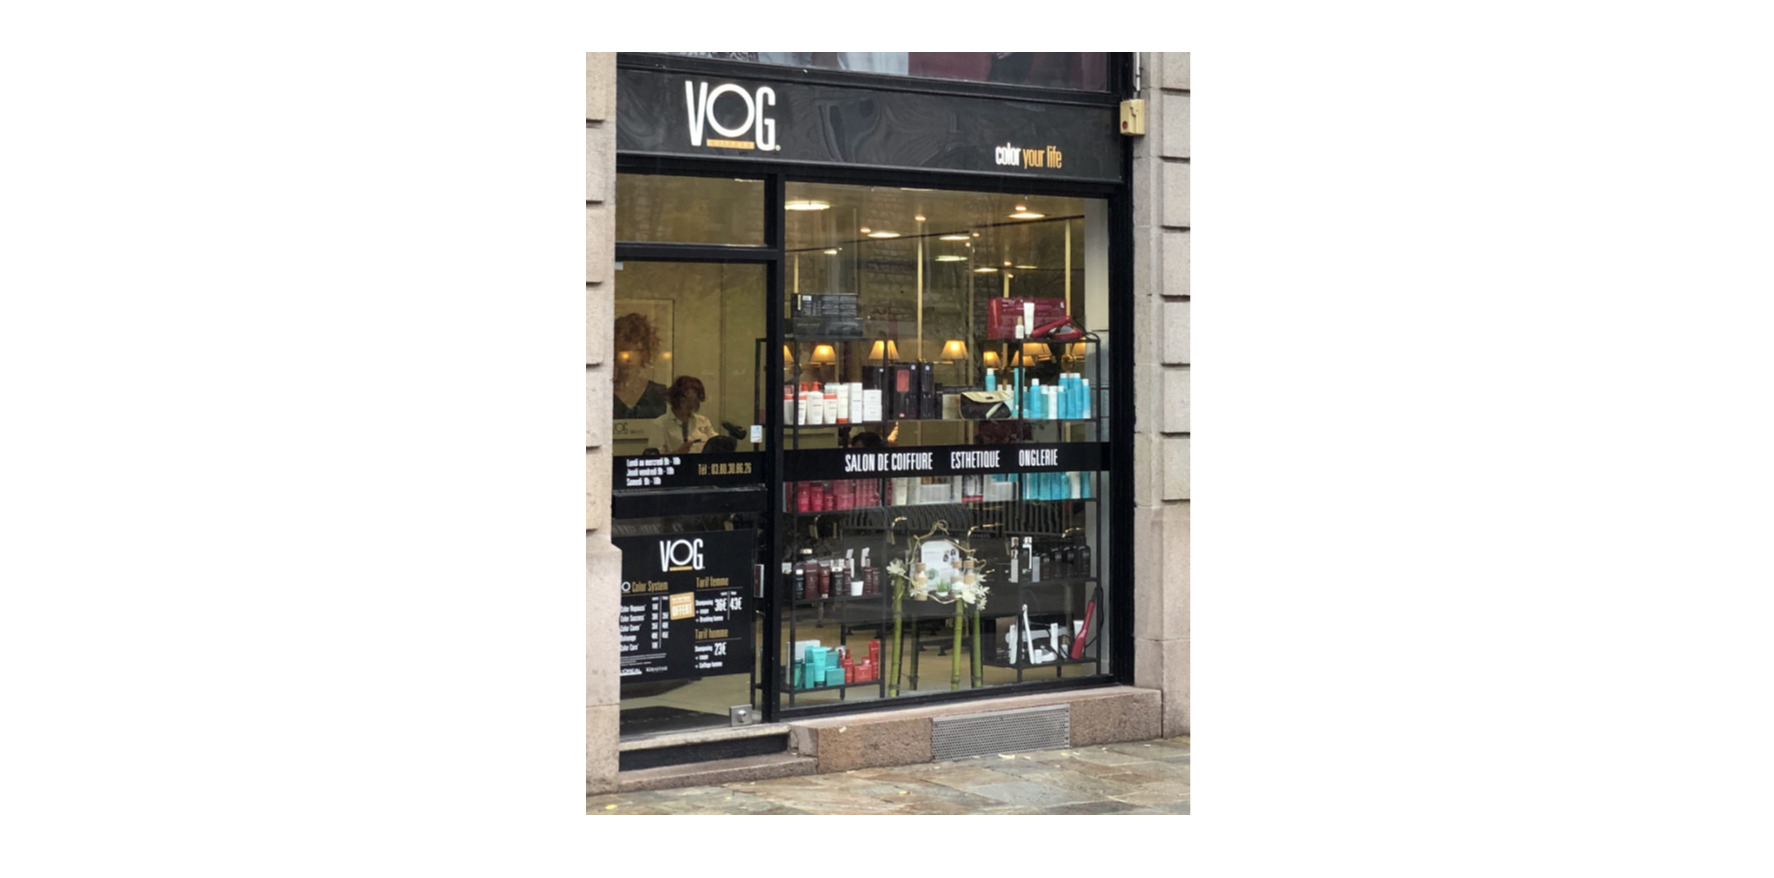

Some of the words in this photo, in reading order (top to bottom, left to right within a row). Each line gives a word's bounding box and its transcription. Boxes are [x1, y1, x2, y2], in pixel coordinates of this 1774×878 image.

[995, 142, 1021, 166] color
[1022, 148, 1045, 170] your
[1046, 145, 1062, 169] life
[844, 453, 875, 472] SALON
[878, 453, 889, 471] DE
[891, 452, 933, 471] COIFFURE
[950, 450, 1000, 469] ESTHETIQUE
[1018, 448, 1058, 466] ONGLERIE
